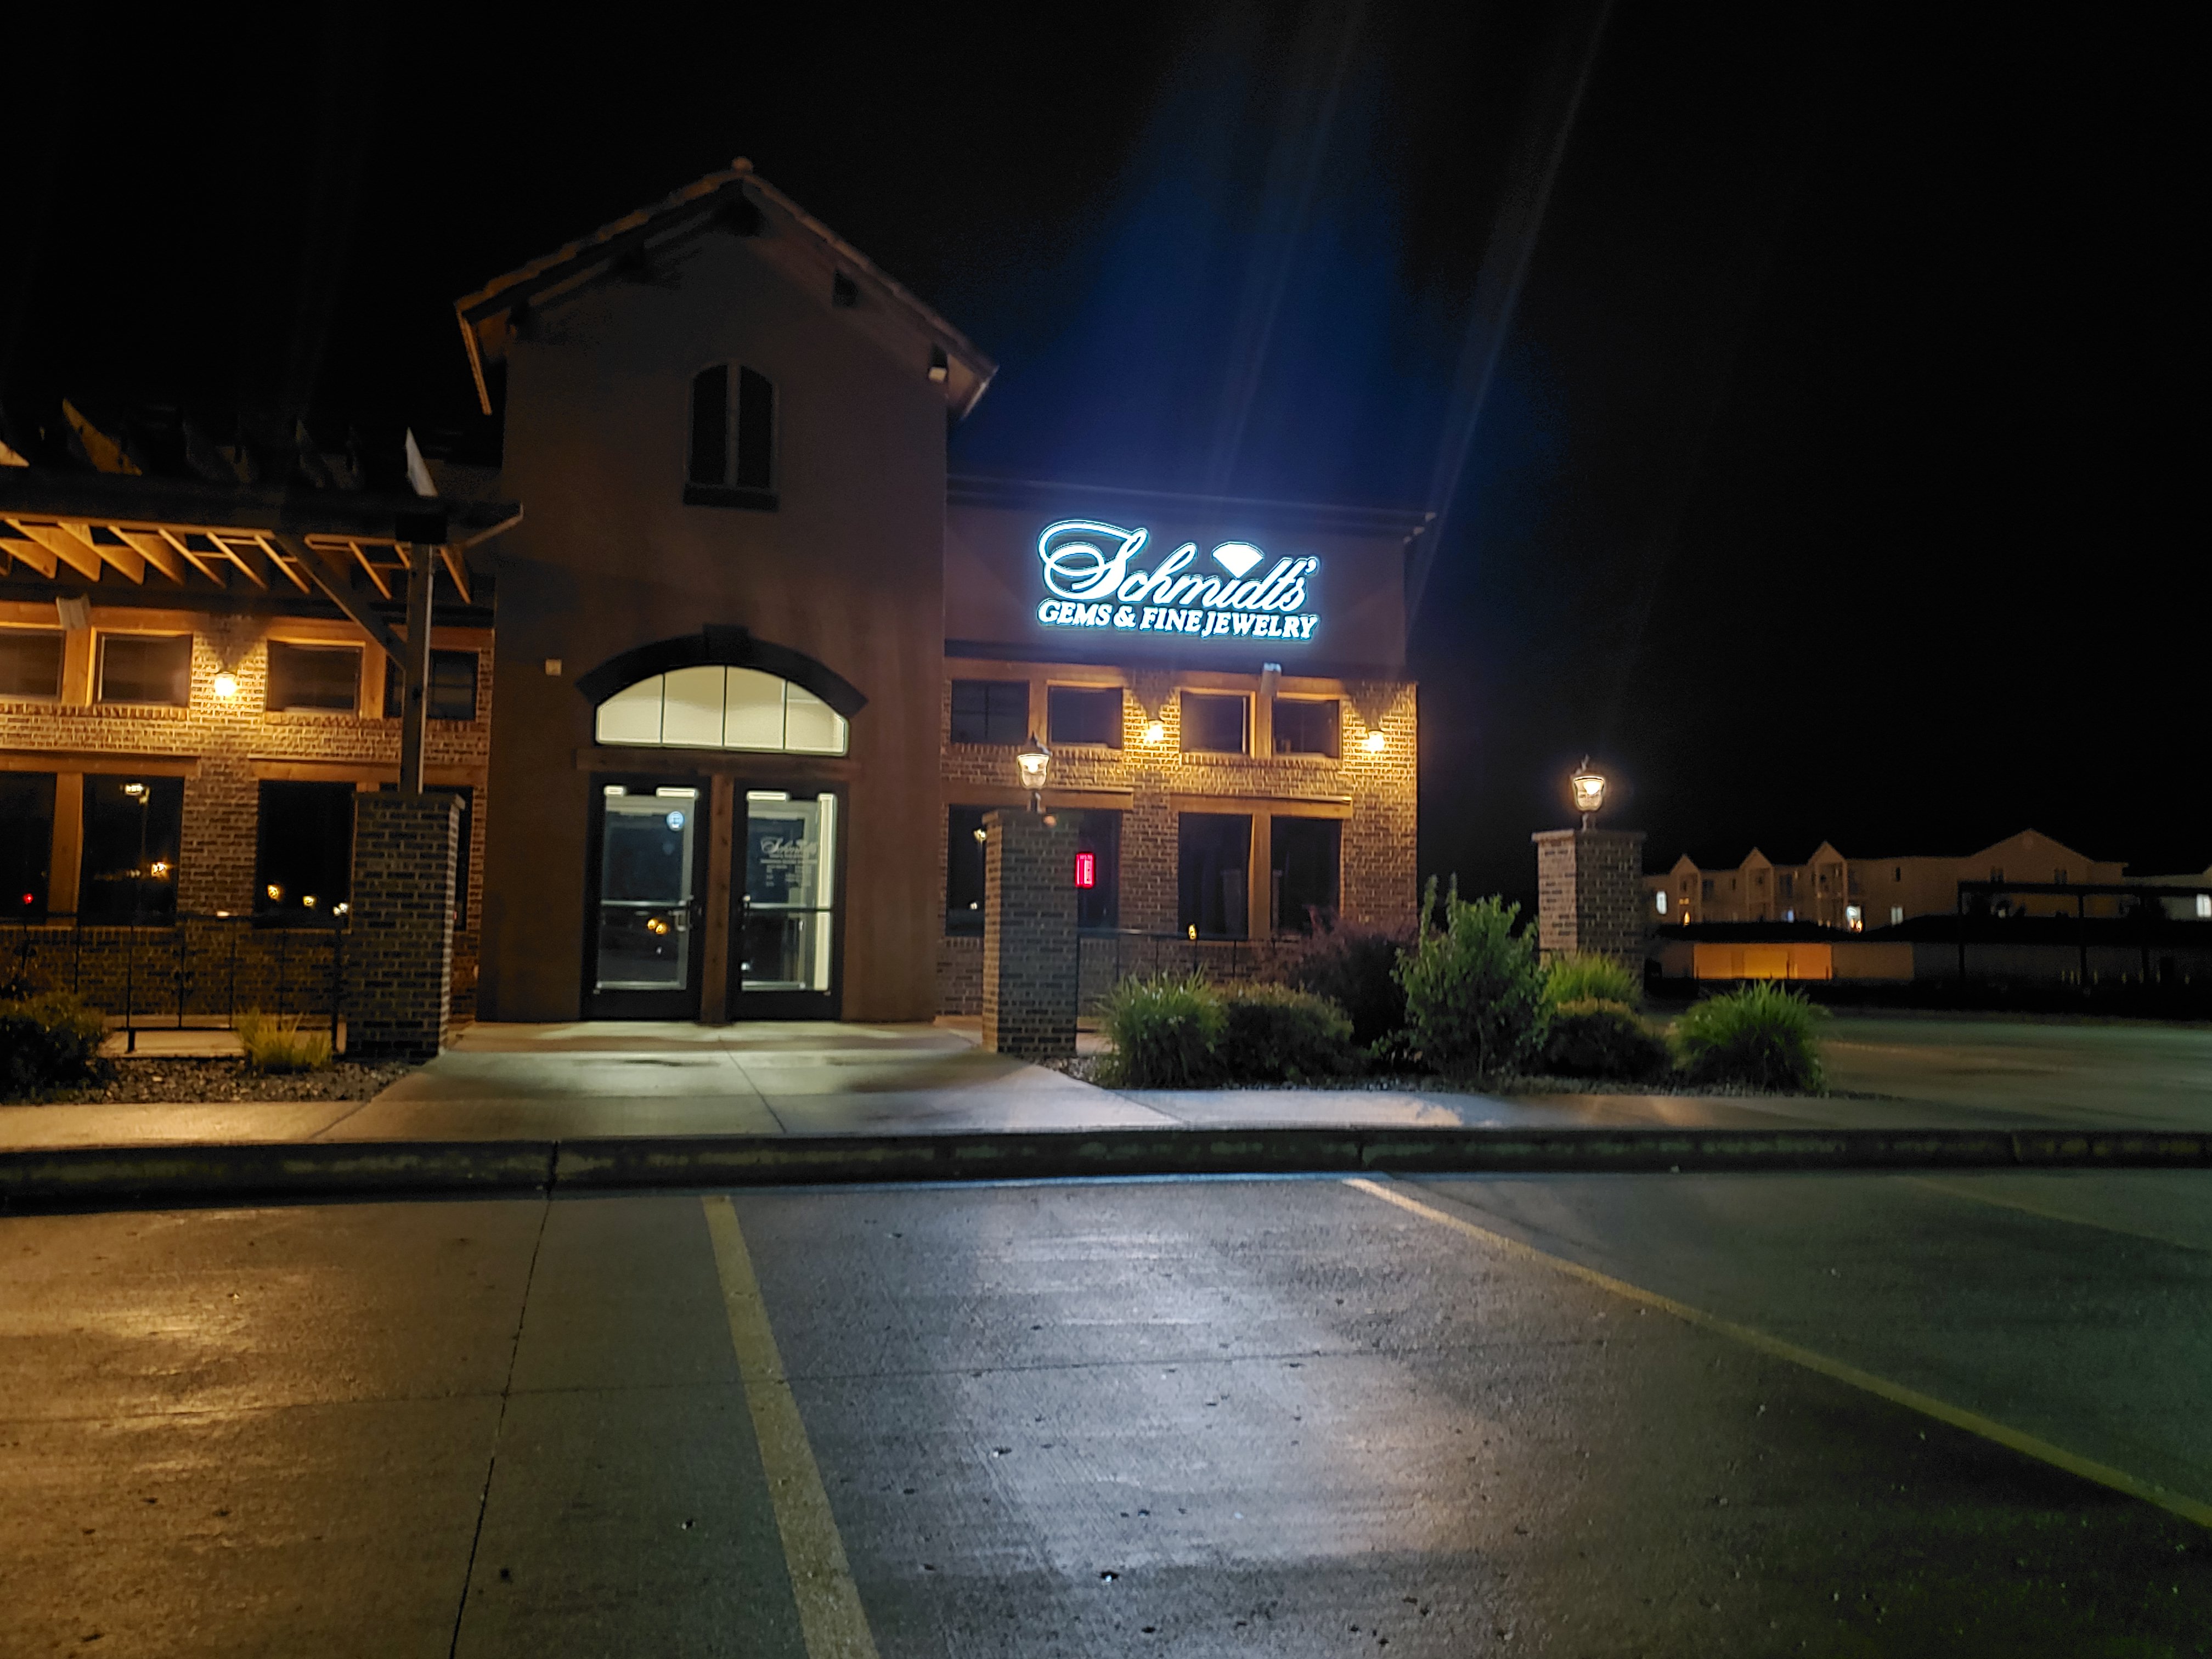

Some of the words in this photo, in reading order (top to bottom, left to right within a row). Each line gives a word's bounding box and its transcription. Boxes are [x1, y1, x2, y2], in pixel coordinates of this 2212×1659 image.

[1037, 600, 1112, 627] GEMS
[1113, 606, 1136, 628] &
[1139, 607, 1203, 633] FINE
[1201, 610, 1318, 639] JEWELRY
